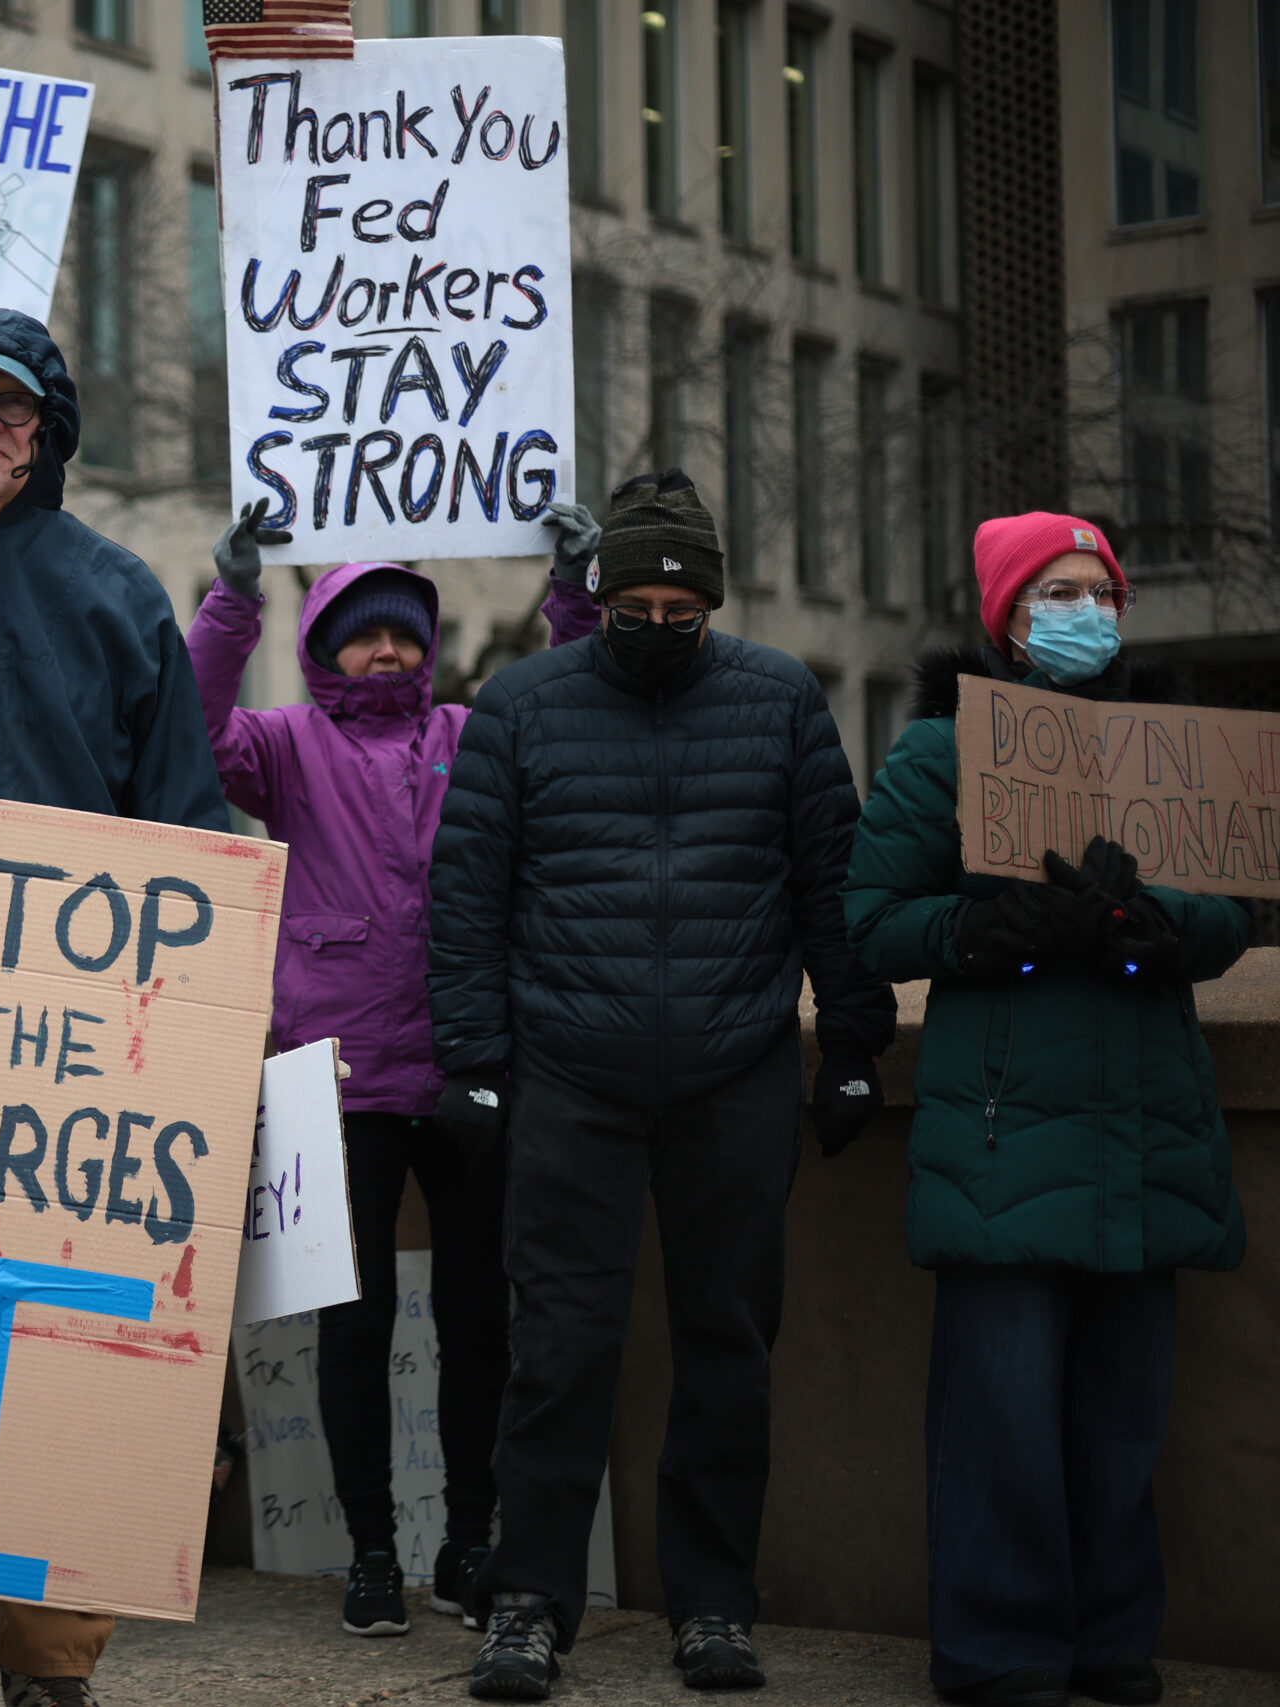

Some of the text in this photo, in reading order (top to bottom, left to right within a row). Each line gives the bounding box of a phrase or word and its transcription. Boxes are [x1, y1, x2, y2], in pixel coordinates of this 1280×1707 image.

[227, 69, 560, 171] Thank You
[300, 173, 450, 253] Fed
[239, 253, 548, 333] Workers
[268, 335, 510, 427] STAY
[246, 429, 559, 531] STRONG
[990, 689, 1204, 790] DOWN
